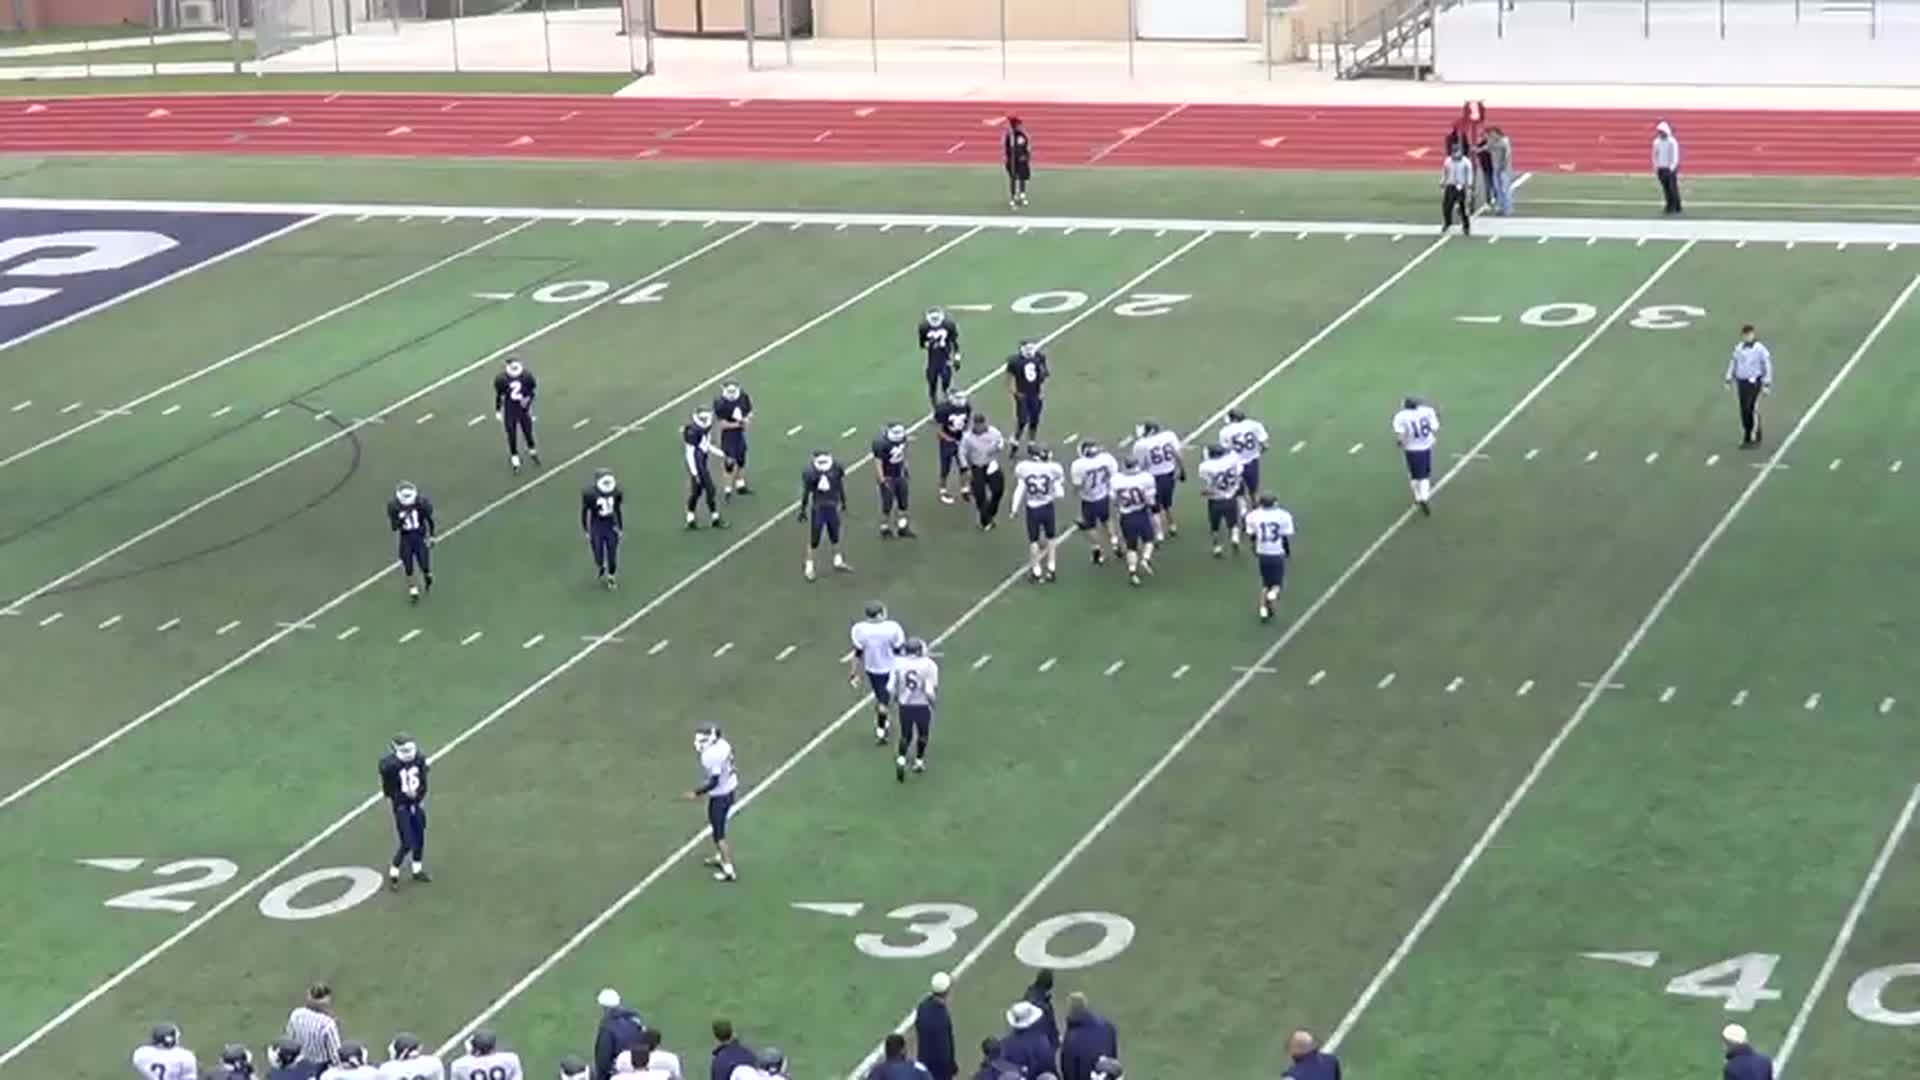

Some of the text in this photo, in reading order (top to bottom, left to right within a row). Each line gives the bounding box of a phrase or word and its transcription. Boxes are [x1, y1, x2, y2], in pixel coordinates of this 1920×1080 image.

[509, 381, 523, 401] 2
[1025, 473, 1051, 496] 63
[1259, 520, 1280, 543] 13
[399, 766, 420, 797] 16
[104, 857, 384, 921] 20
[854, 902, 1136, 969] 30
